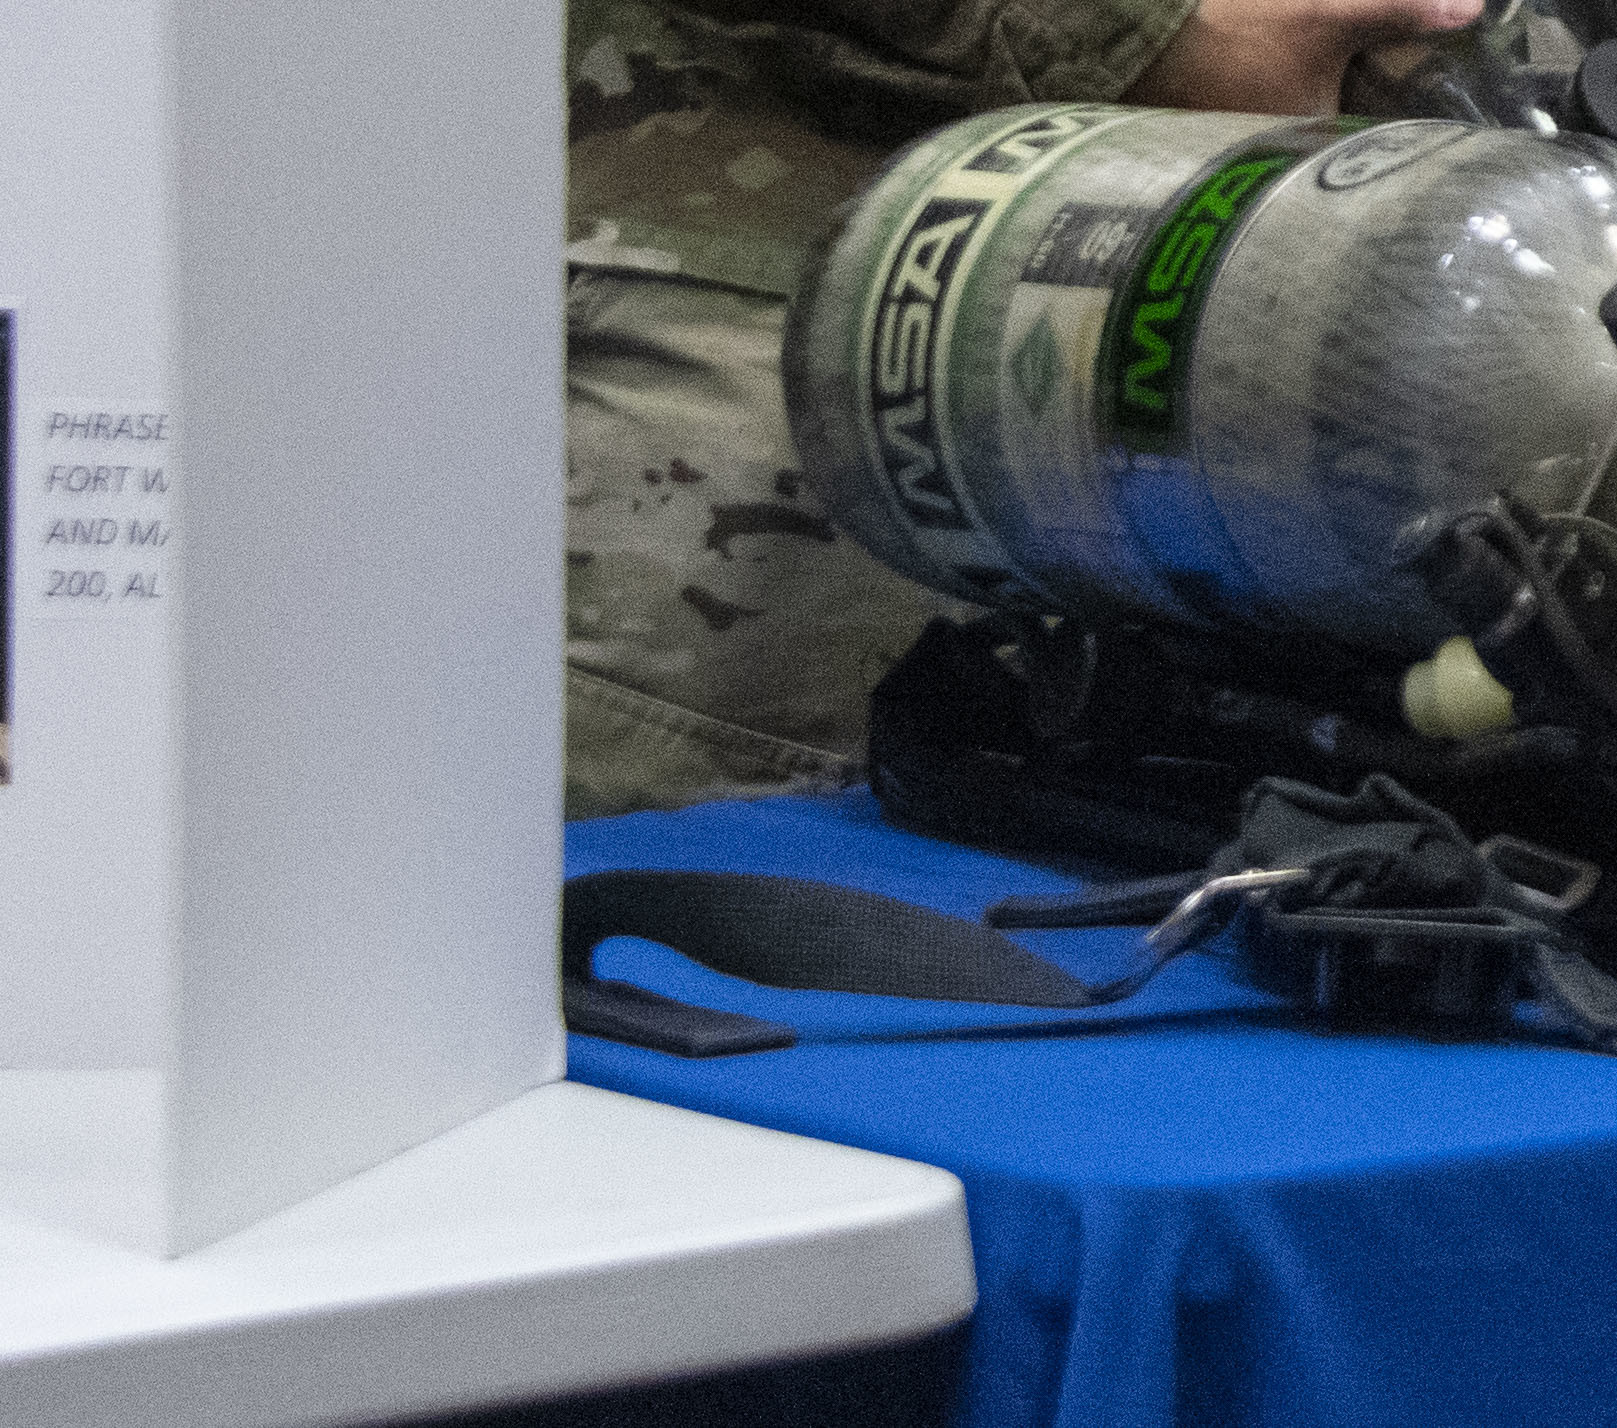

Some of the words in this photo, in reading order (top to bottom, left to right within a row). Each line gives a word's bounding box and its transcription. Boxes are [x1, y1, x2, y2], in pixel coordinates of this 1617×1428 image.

[1122, 153, 1291, 412] MSA
[877, 211, 977, 513] MSA
[45, 516, 119, 546] AND
[47, 464, 133, 495] FORT
